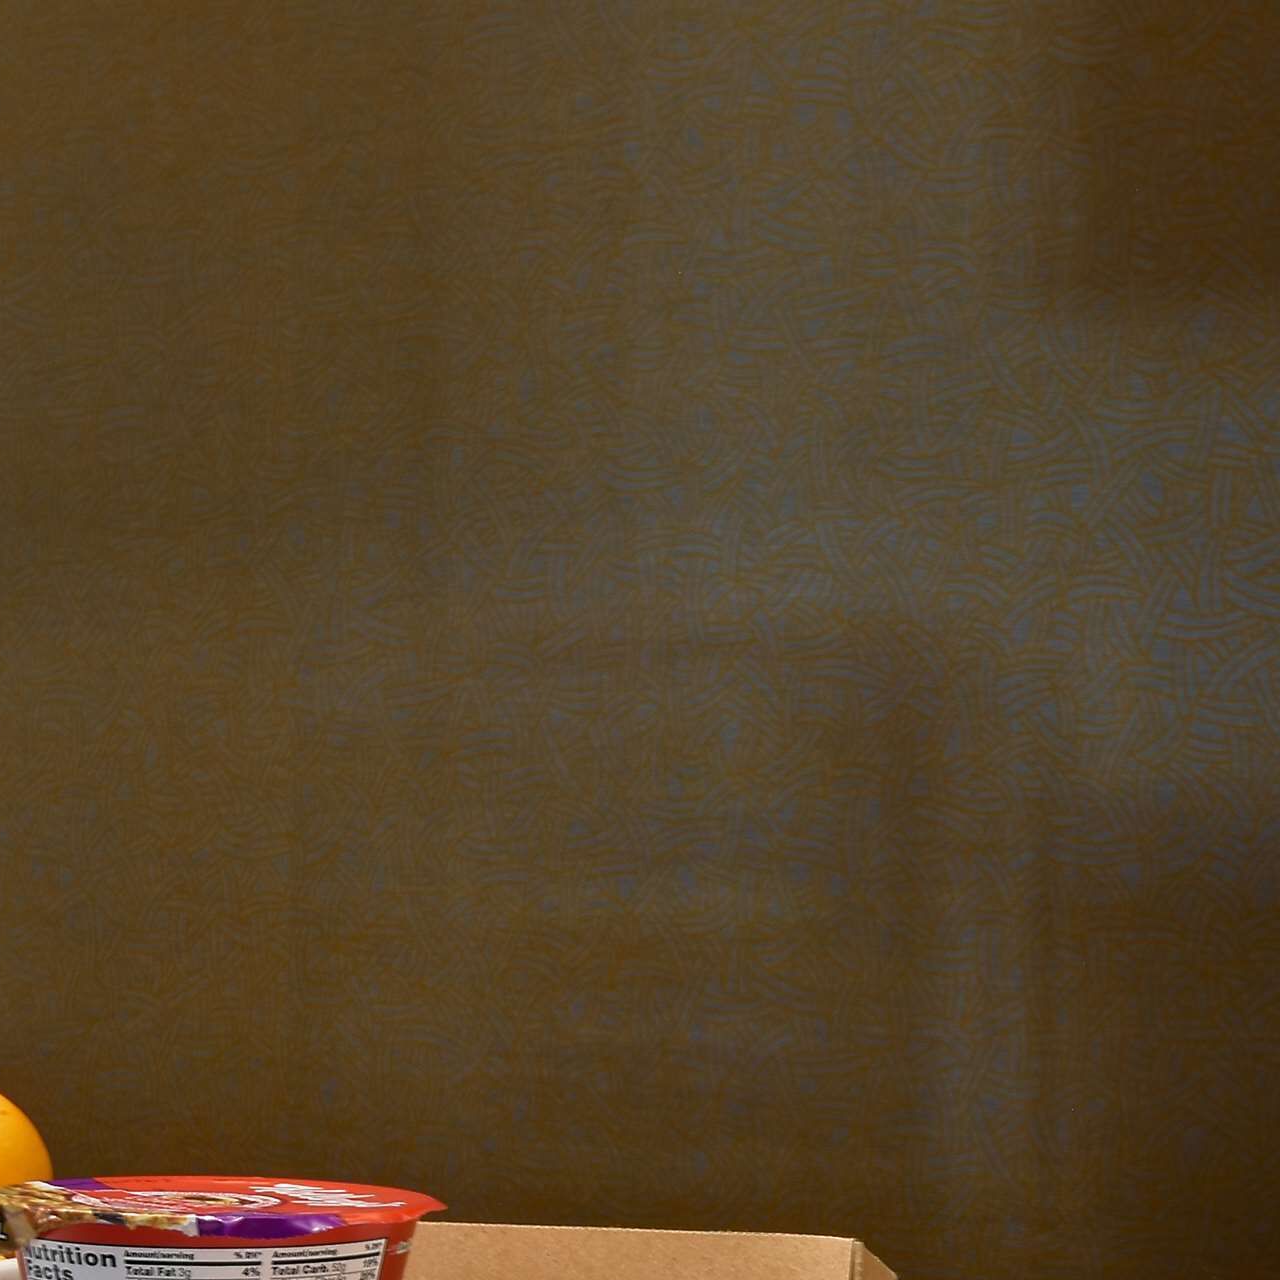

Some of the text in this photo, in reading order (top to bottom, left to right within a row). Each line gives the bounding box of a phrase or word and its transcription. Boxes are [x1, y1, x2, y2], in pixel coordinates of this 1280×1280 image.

[125, 1266, 176, 1276] Total Fat
[272, 1266, 299, 1276] Total
